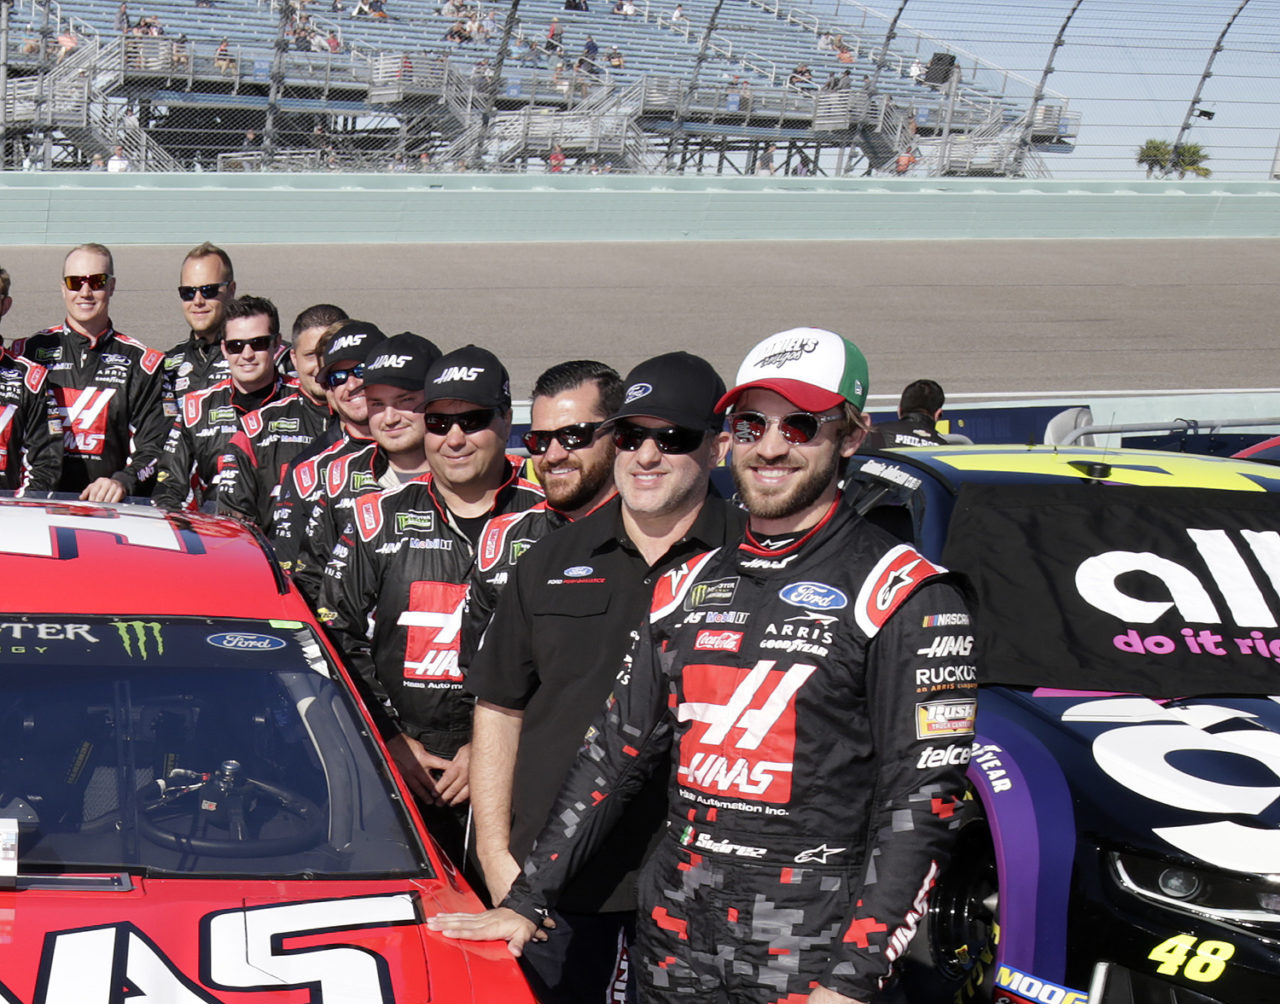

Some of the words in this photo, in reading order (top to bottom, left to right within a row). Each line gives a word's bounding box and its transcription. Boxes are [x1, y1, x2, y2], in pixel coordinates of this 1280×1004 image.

[328, 333, 367, 355] HAAS
[368, 354, 413, 370] HAAS
[433, 366, 485, 384] HAAS
[409, 538, 440, 549] Mobil
[786, 584, 838, 608] Ford
[218, 633, 276, 650] Ford
[764, 623, 833, 644] ARRIS
[1112, 629, 1176, 655] do
[1180, 627, 1228, 656] it
[759, 638, 829, 657] GOODYEAR
[916, 635, 975, 658] HAAS
[930, 683, 956, 692] ARRIS
[916, 744, 970, 769] telce
[677, 752, 794, 795] HAAS
[1147, 933, 1236, 983] 48
